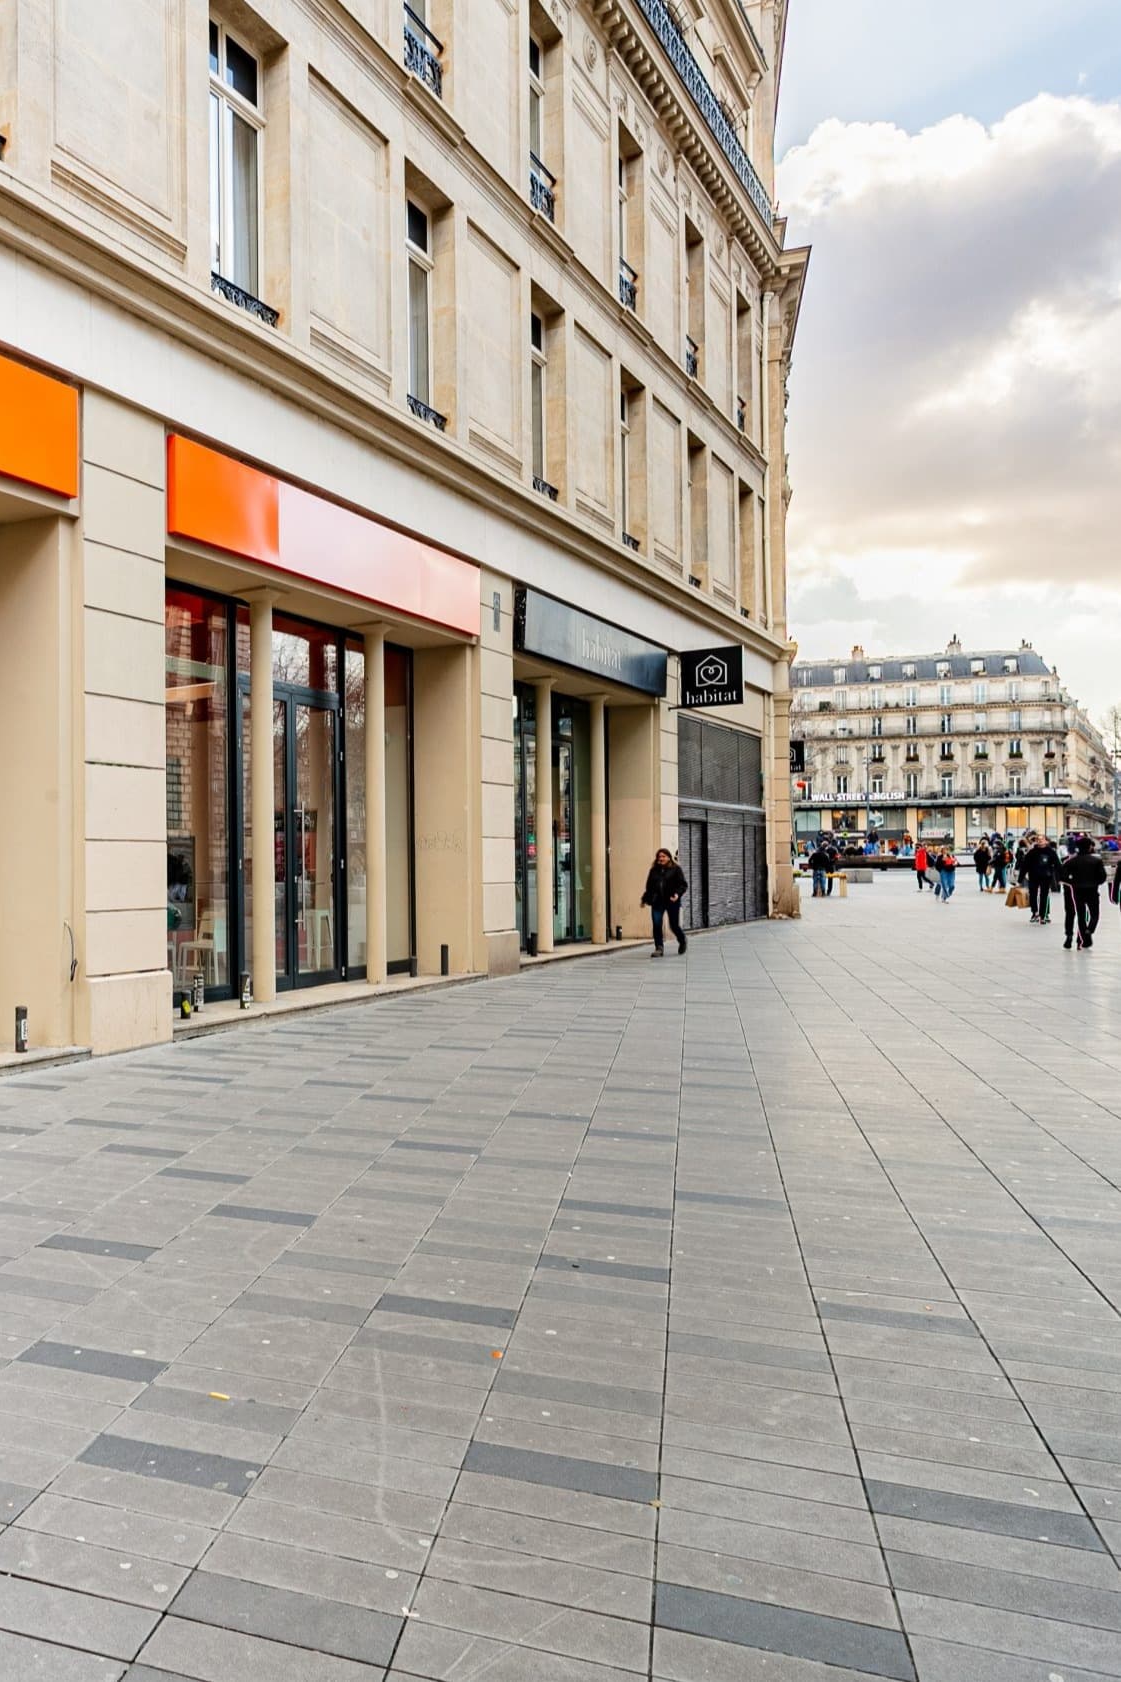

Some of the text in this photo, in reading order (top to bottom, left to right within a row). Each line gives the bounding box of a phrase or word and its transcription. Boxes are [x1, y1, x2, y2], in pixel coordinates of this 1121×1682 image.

[581, 627, 622, 671] habitat
[686, 689, 737, 704] habitat
[811, 793, 833, 801] WALL
[836, 792, 865, 801] STREET
